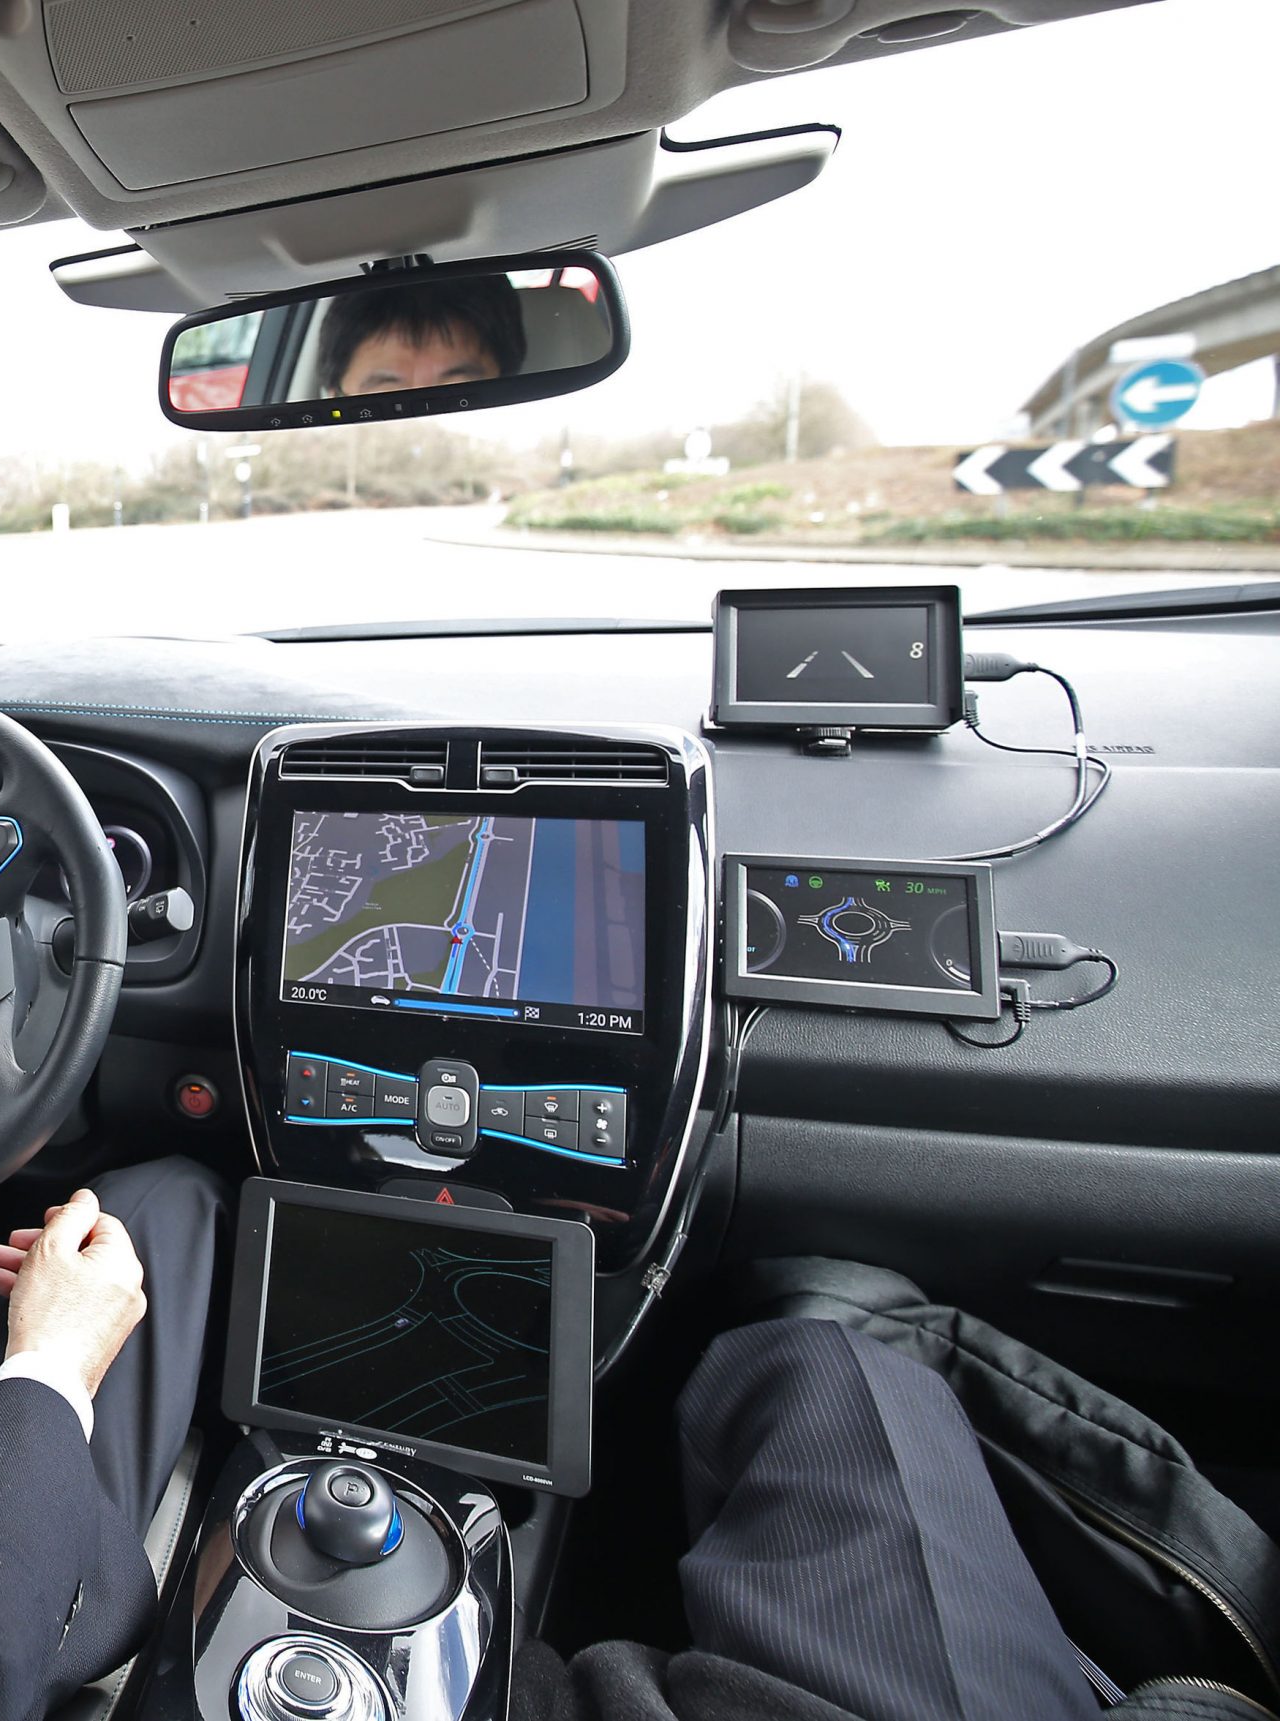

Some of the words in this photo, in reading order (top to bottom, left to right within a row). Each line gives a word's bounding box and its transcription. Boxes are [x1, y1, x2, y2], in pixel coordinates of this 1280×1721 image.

[910, 642, 924, 659] 8
[905, 881, 924, 894] 30
[577, 1012, 606, 1027] 1:20
[610, 1014, 632, 1029] PM
[384, 1094, 410, 1105] MODE
[435, 1102, 460, 1111] AUTO
[340, 1103, 358, 1112] A/C
[344, 1481, 359, 1496] P
[294, 1669, 322, 1685] ENTER
